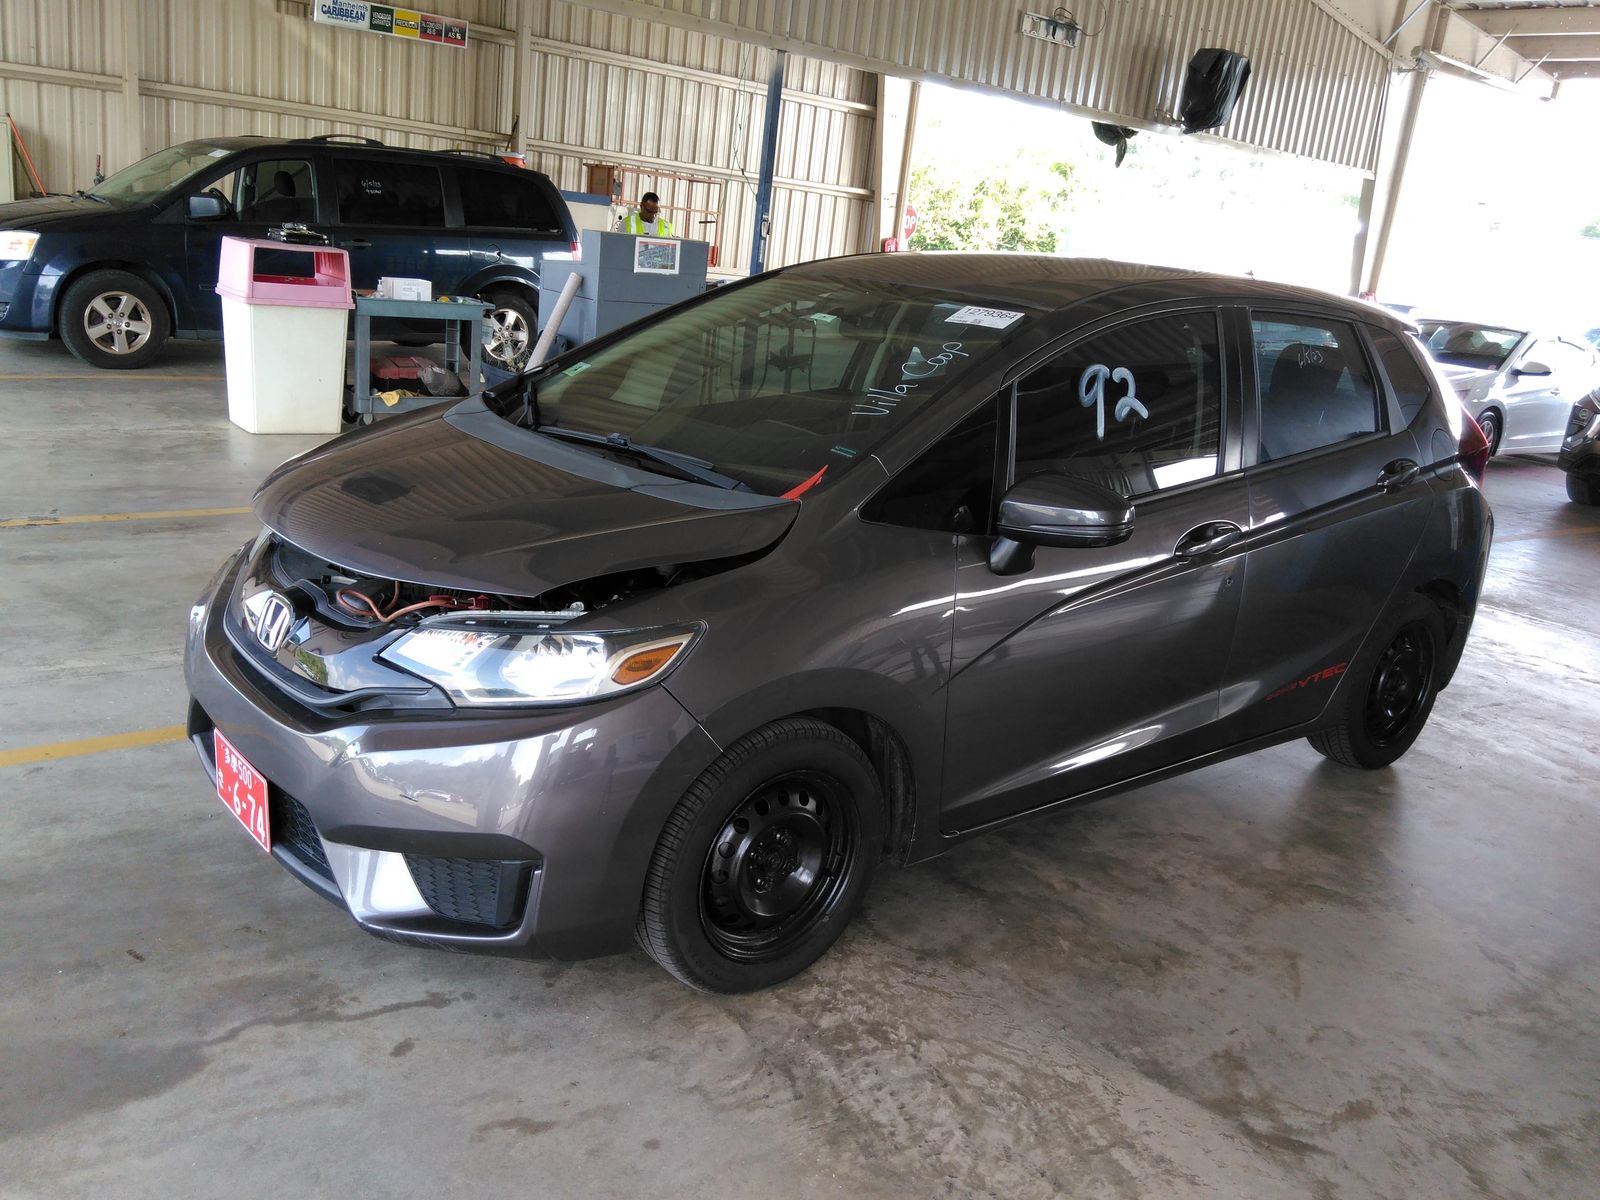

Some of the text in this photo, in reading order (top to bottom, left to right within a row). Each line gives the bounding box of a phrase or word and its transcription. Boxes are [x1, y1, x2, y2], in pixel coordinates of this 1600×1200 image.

[321, 4, 366, 21] CARIBBEAN
[964, 307, 1018, 320] 1279364
[1078, 363, 1149, 441] 92
